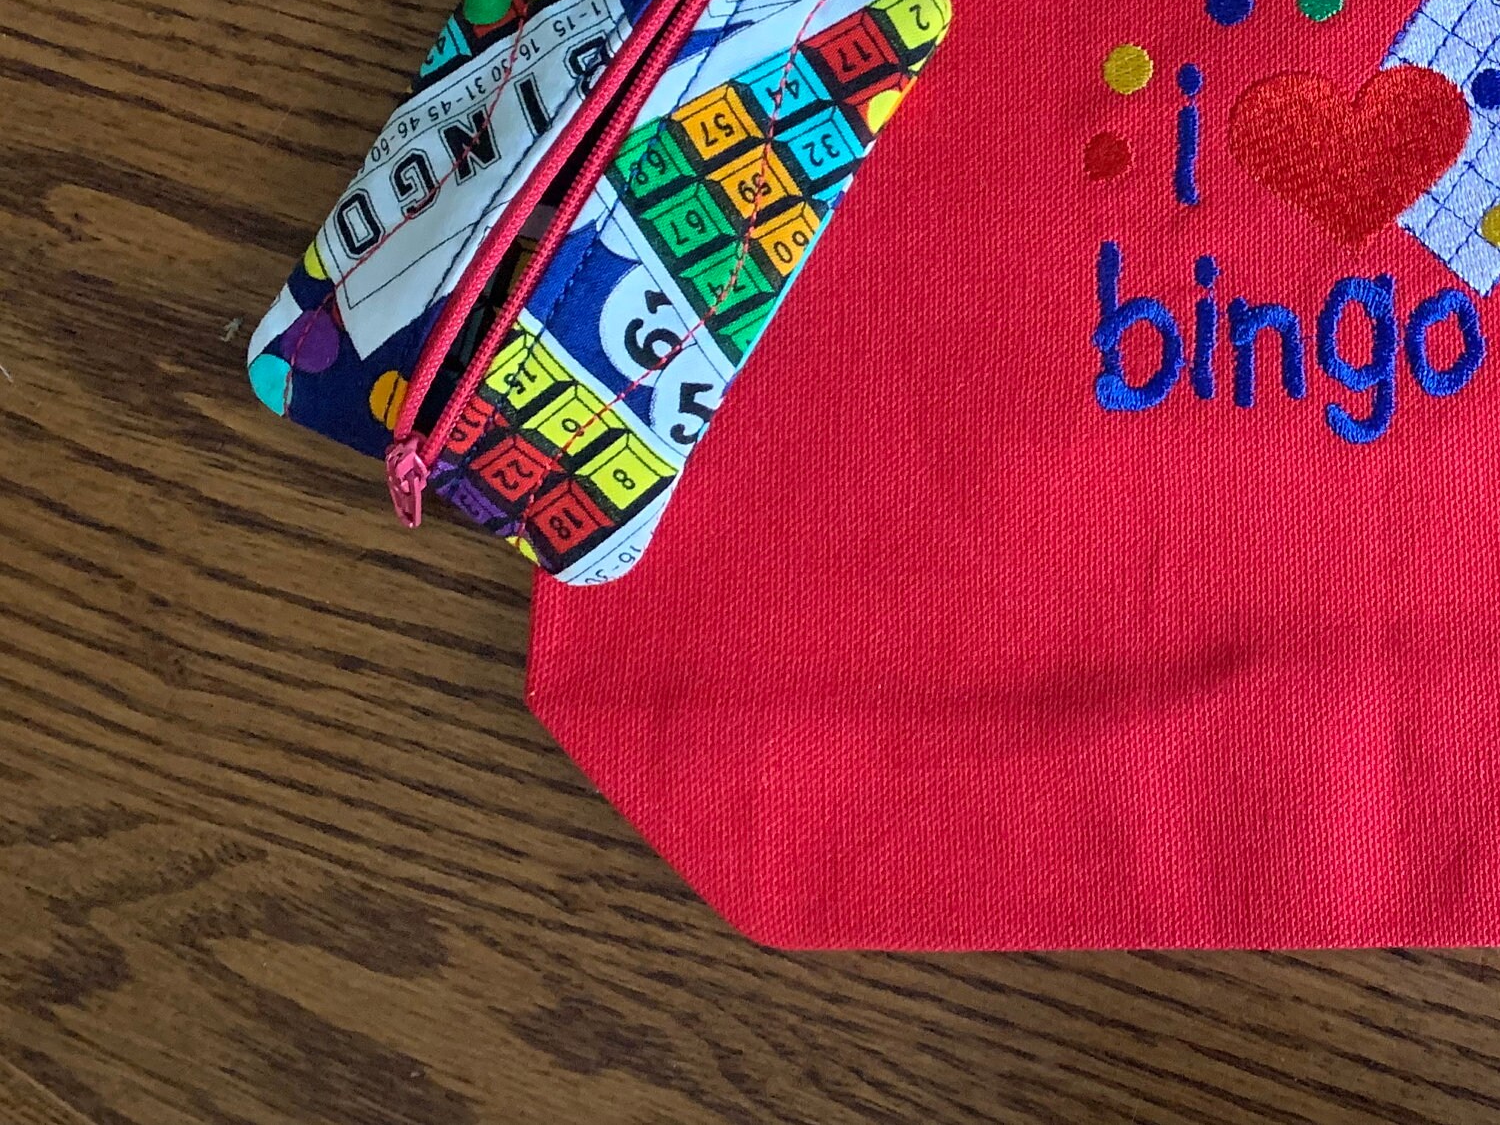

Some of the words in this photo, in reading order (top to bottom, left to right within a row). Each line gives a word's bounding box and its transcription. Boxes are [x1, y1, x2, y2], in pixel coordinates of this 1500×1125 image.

[553, 1, 602, 37] 1-15
[909, 5, 930, 31] 2
[837, 41, 872, 72] 17
[428, 76, 487, 123] 31-45
[371, 116, 421, 163] 46-60
[699, 112, 735, 147] 57
[1173, 62, 1203, 206] i
[802, 133, 840, 166] 32
[670, 210, 706, 245] 67
[1092, 240, 1488, 445] bingo
[492, 459, 533, 491] 22
[613, 469, 636, 490] 8
[550, 508, 582, 541] 18
